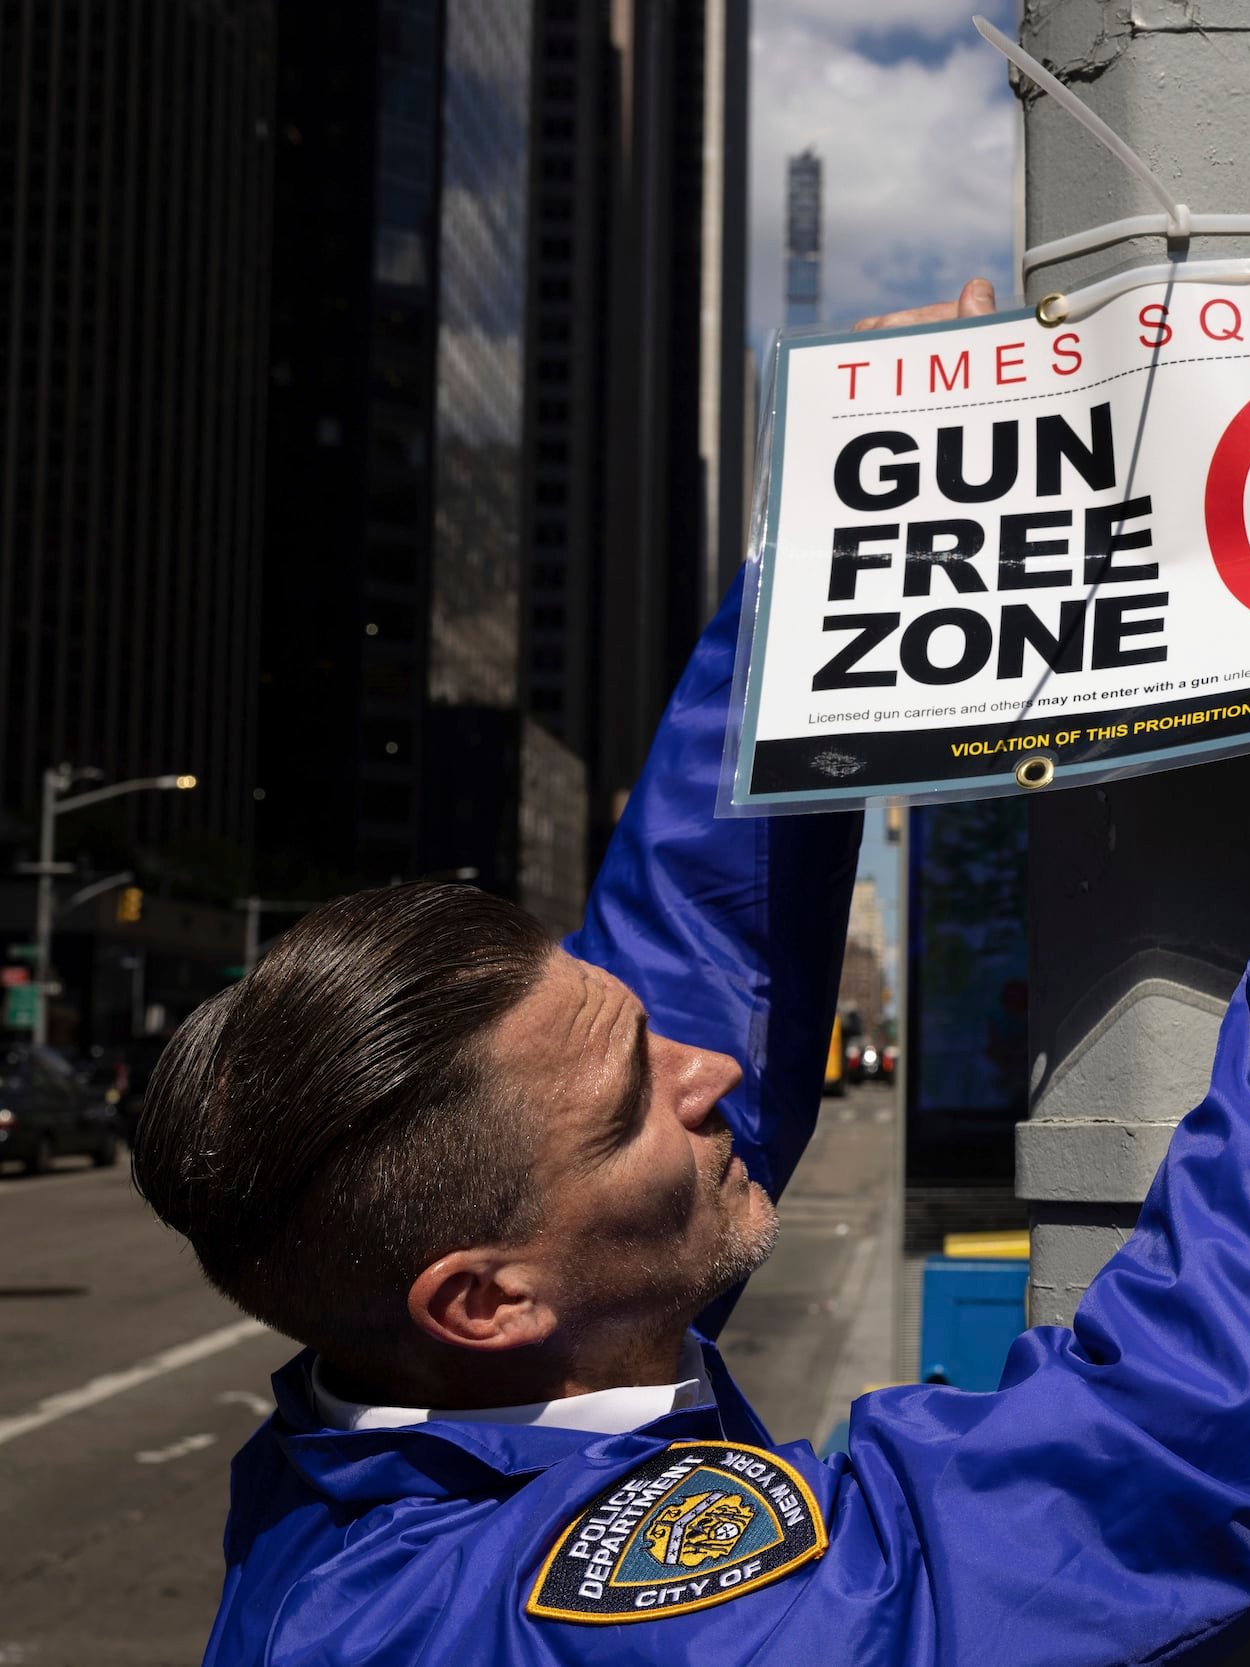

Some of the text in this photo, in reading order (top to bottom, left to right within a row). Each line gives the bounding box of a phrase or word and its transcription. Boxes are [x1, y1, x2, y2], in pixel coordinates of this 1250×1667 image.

[837, 332, 1084, 402] TIMES
[832, 401, 1116, 513] GUN
[827, 494, 1159, 603] FREE
[811, 590, 1169, 692] ZONE
[808, 709, 870, 725] Licensed
[873, 709, 900, 723] gun
[904, 705, 956, 719] carriers
[960, 702, 986, 714] and
[990, 699, 1033, 713] others
[1038, 695, 1068, 707] may
[1072, 691, 1097, 703] not
[1101, 686, 1140, 699] enter
[1143, 682, 1174, 694] with
[1178, 680, 1187, 689] a
[1191, 675, 1219, 689] gun
[951, 733, 1050, 758] VIOLATION
[1055, 729, 1081, 746] OF
[1086, 723, 1129, 743] THIS
[568, 1479, 653, 1559] POLICE
[578, 1455, 703, 1600] DEPARTMENT
[719, 1451, 805, 1527] NEW YORK
[634, 1560, 762, 1608] CITY OF
